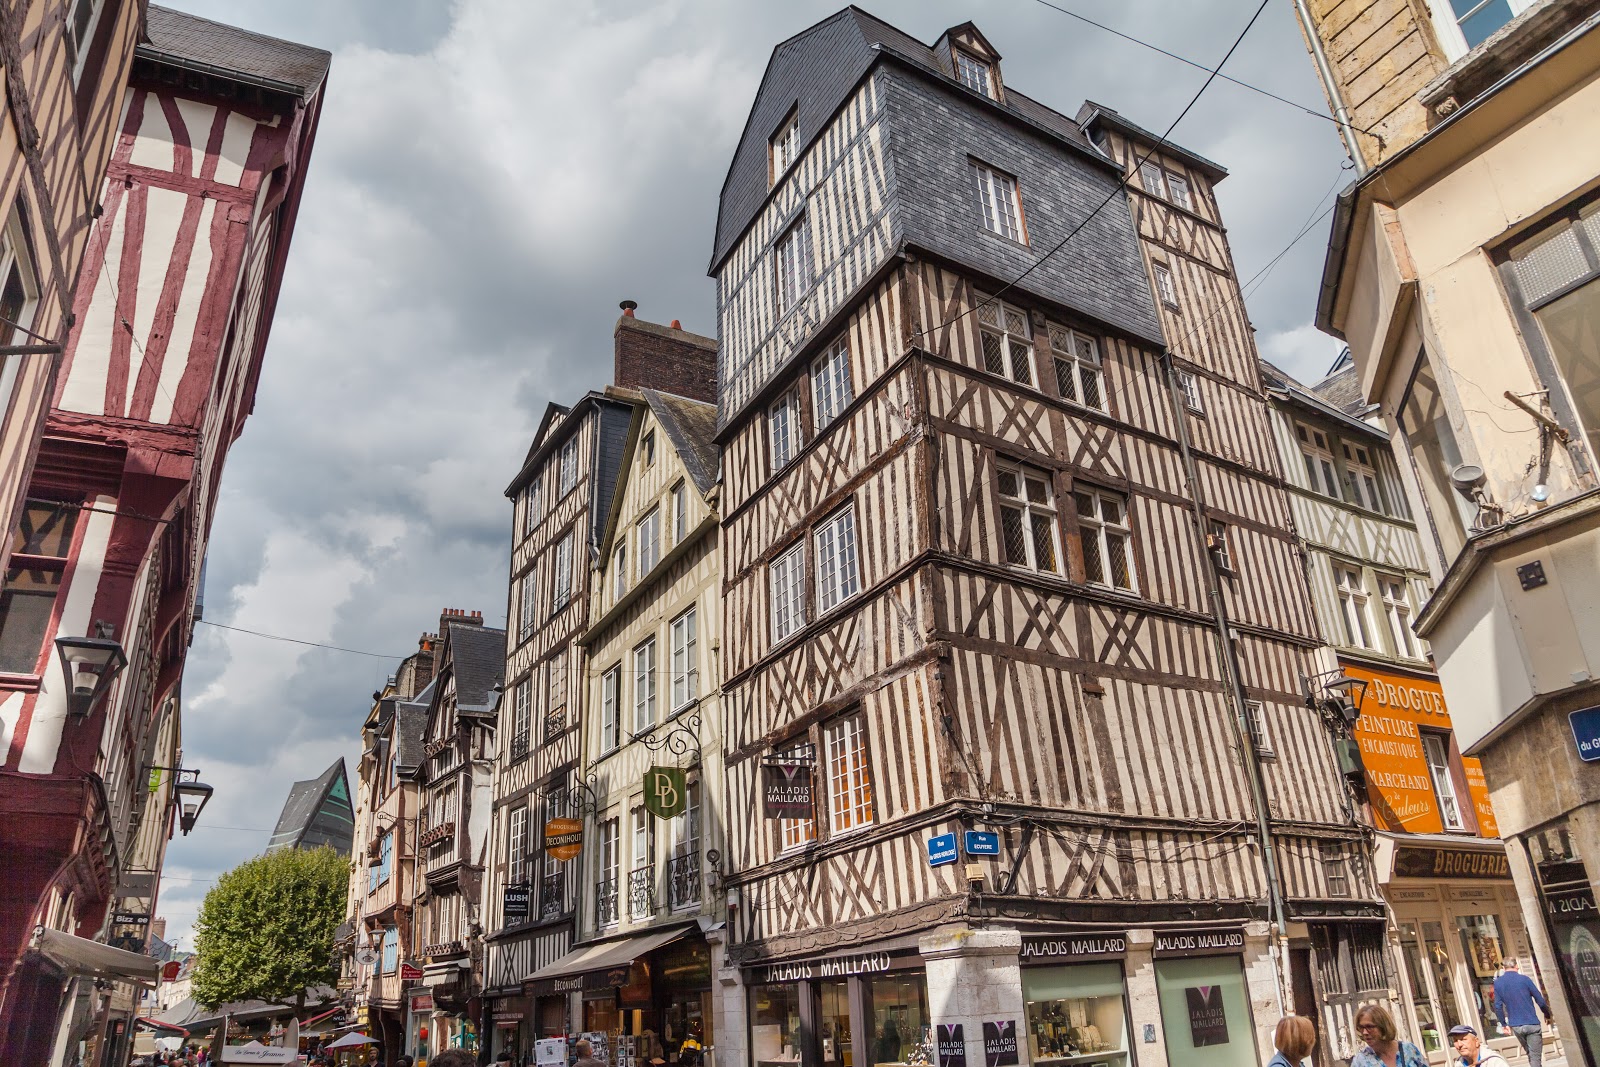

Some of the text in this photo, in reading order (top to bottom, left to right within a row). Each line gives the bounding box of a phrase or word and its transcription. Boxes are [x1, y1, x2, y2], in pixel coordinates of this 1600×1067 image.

[1373, 679, 1449, 715] DROGUE
[1362, 738, 1418, 759] ENCAUSTIQUE
[1580, 737, 1600, 751] du G
[1367, 769, 1429, 790] MARCHAND
[767, 786, 809, 794] JALADIS
[1393, 790, 1401, 800] de
[767, 794, 810, 803] MAILLARD
[1377, 795, 1431, 821] Couleurs
[546, 833, 582, 847] DECONIHOUT
[1433, 849, 1508, 876] DROGUERIE
[116, 915, 148, 923] Bizzee
[1021, 938, 1125, 957] JALADIS MAILLARD
[1155, 933, 1242, 950] JALADIS MAILLARD
[766, 951, 890, 982] JALADIS MAILLARD
[554, 975, 584, 991] DECONIHOUT
[492, 998, 508, 1012] LUSH
[1192, 1008, 1222, 1019] JALADIS
[1192, 1018, 1224, 1028] MAILLARD
[987, 1038, 1016, 1047] JALADIS
[987, 1045, 1016, 1054] MAILLARD
[940, 1048, 964, 1056] MAILLARD
